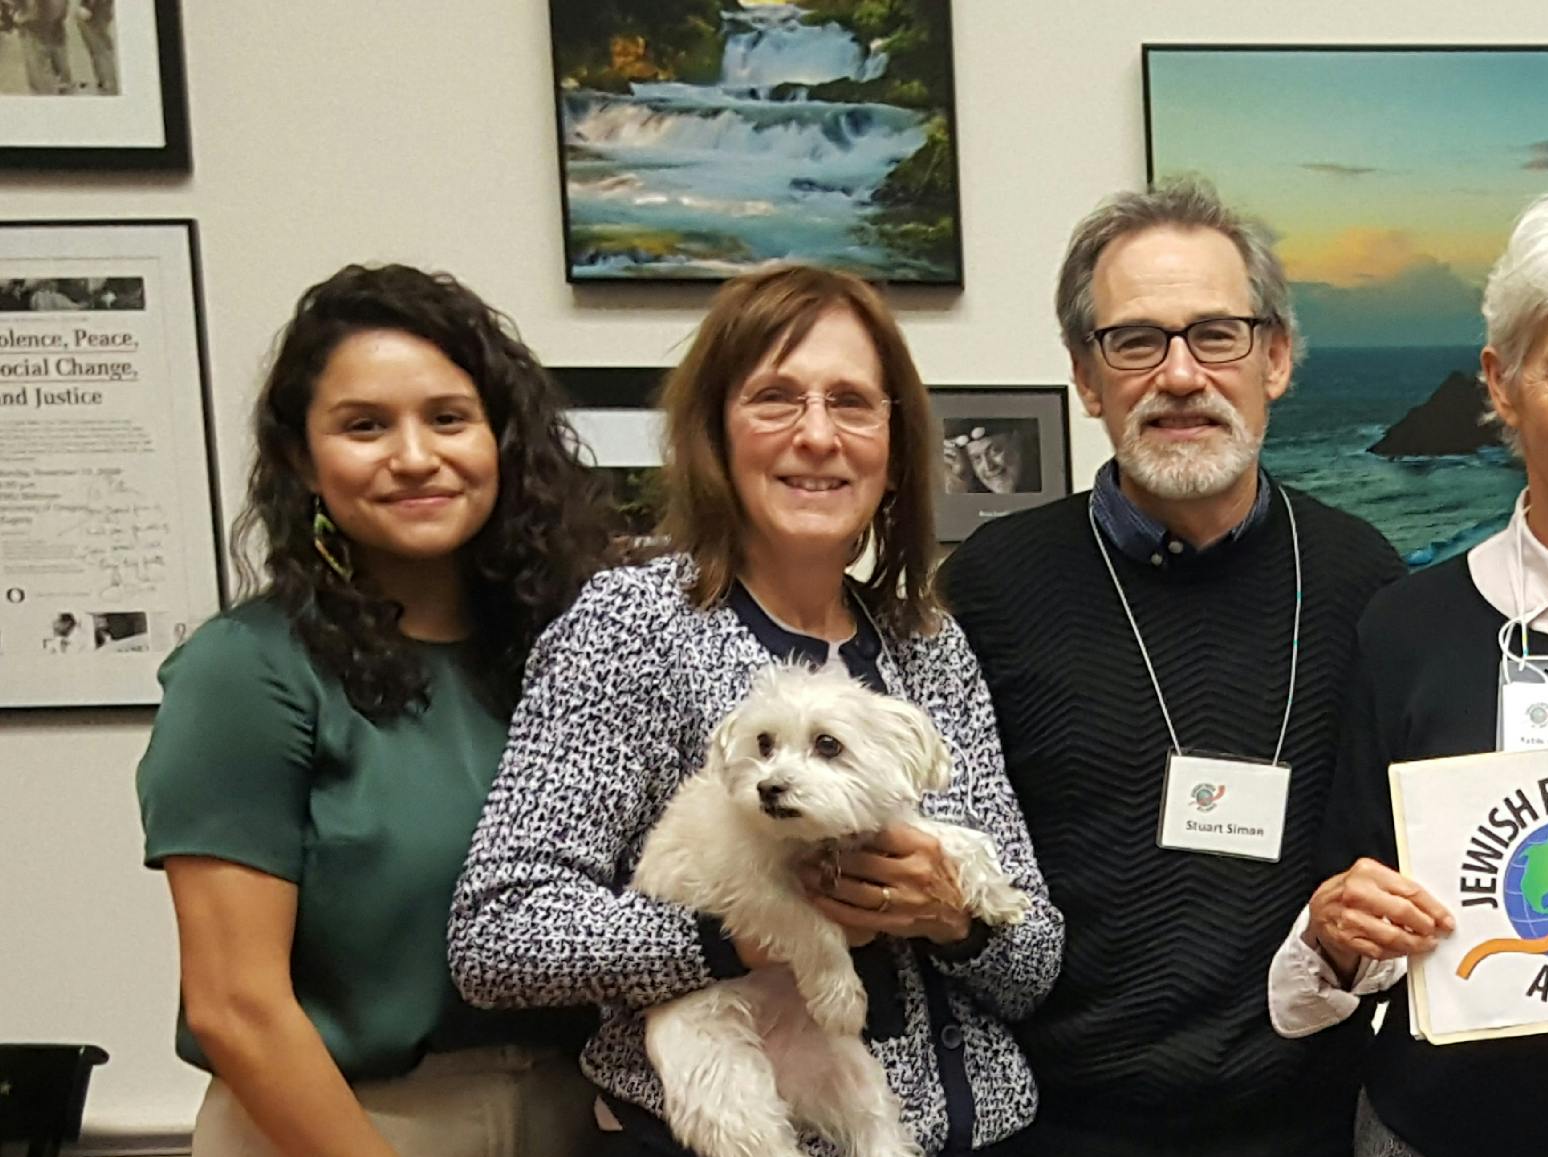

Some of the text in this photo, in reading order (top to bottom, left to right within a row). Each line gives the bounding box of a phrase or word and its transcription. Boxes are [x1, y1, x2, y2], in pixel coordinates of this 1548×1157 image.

[73, 328, 139, 348] Peace,
[0, 357, 138, 381] ocial Change,
[35, 387, 103, 408] Justice
[1185, 820, 1223, 834] Stuart
[1460, 789, 1540, 908] JEWISH
